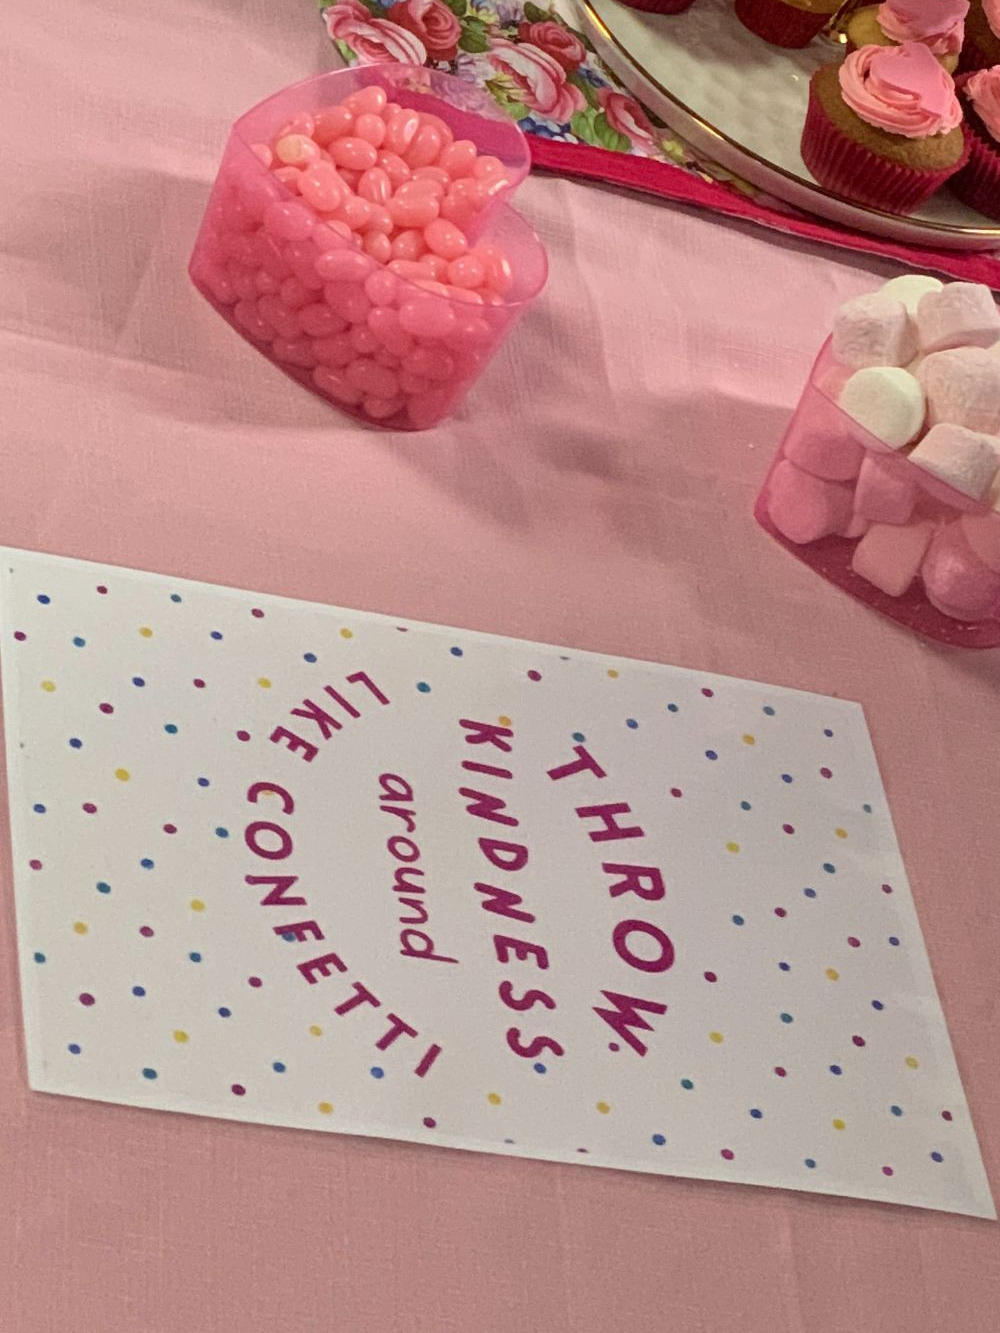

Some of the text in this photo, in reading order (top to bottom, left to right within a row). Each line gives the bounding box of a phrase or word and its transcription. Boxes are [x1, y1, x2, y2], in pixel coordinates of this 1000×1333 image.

[245, 671, 442, 1078] LIKE CONFETTI
[379, 773, 459, 963] around
[459, 719, 564, 1059] KINDNESS
[547, 745, 675, 1057] THROW
